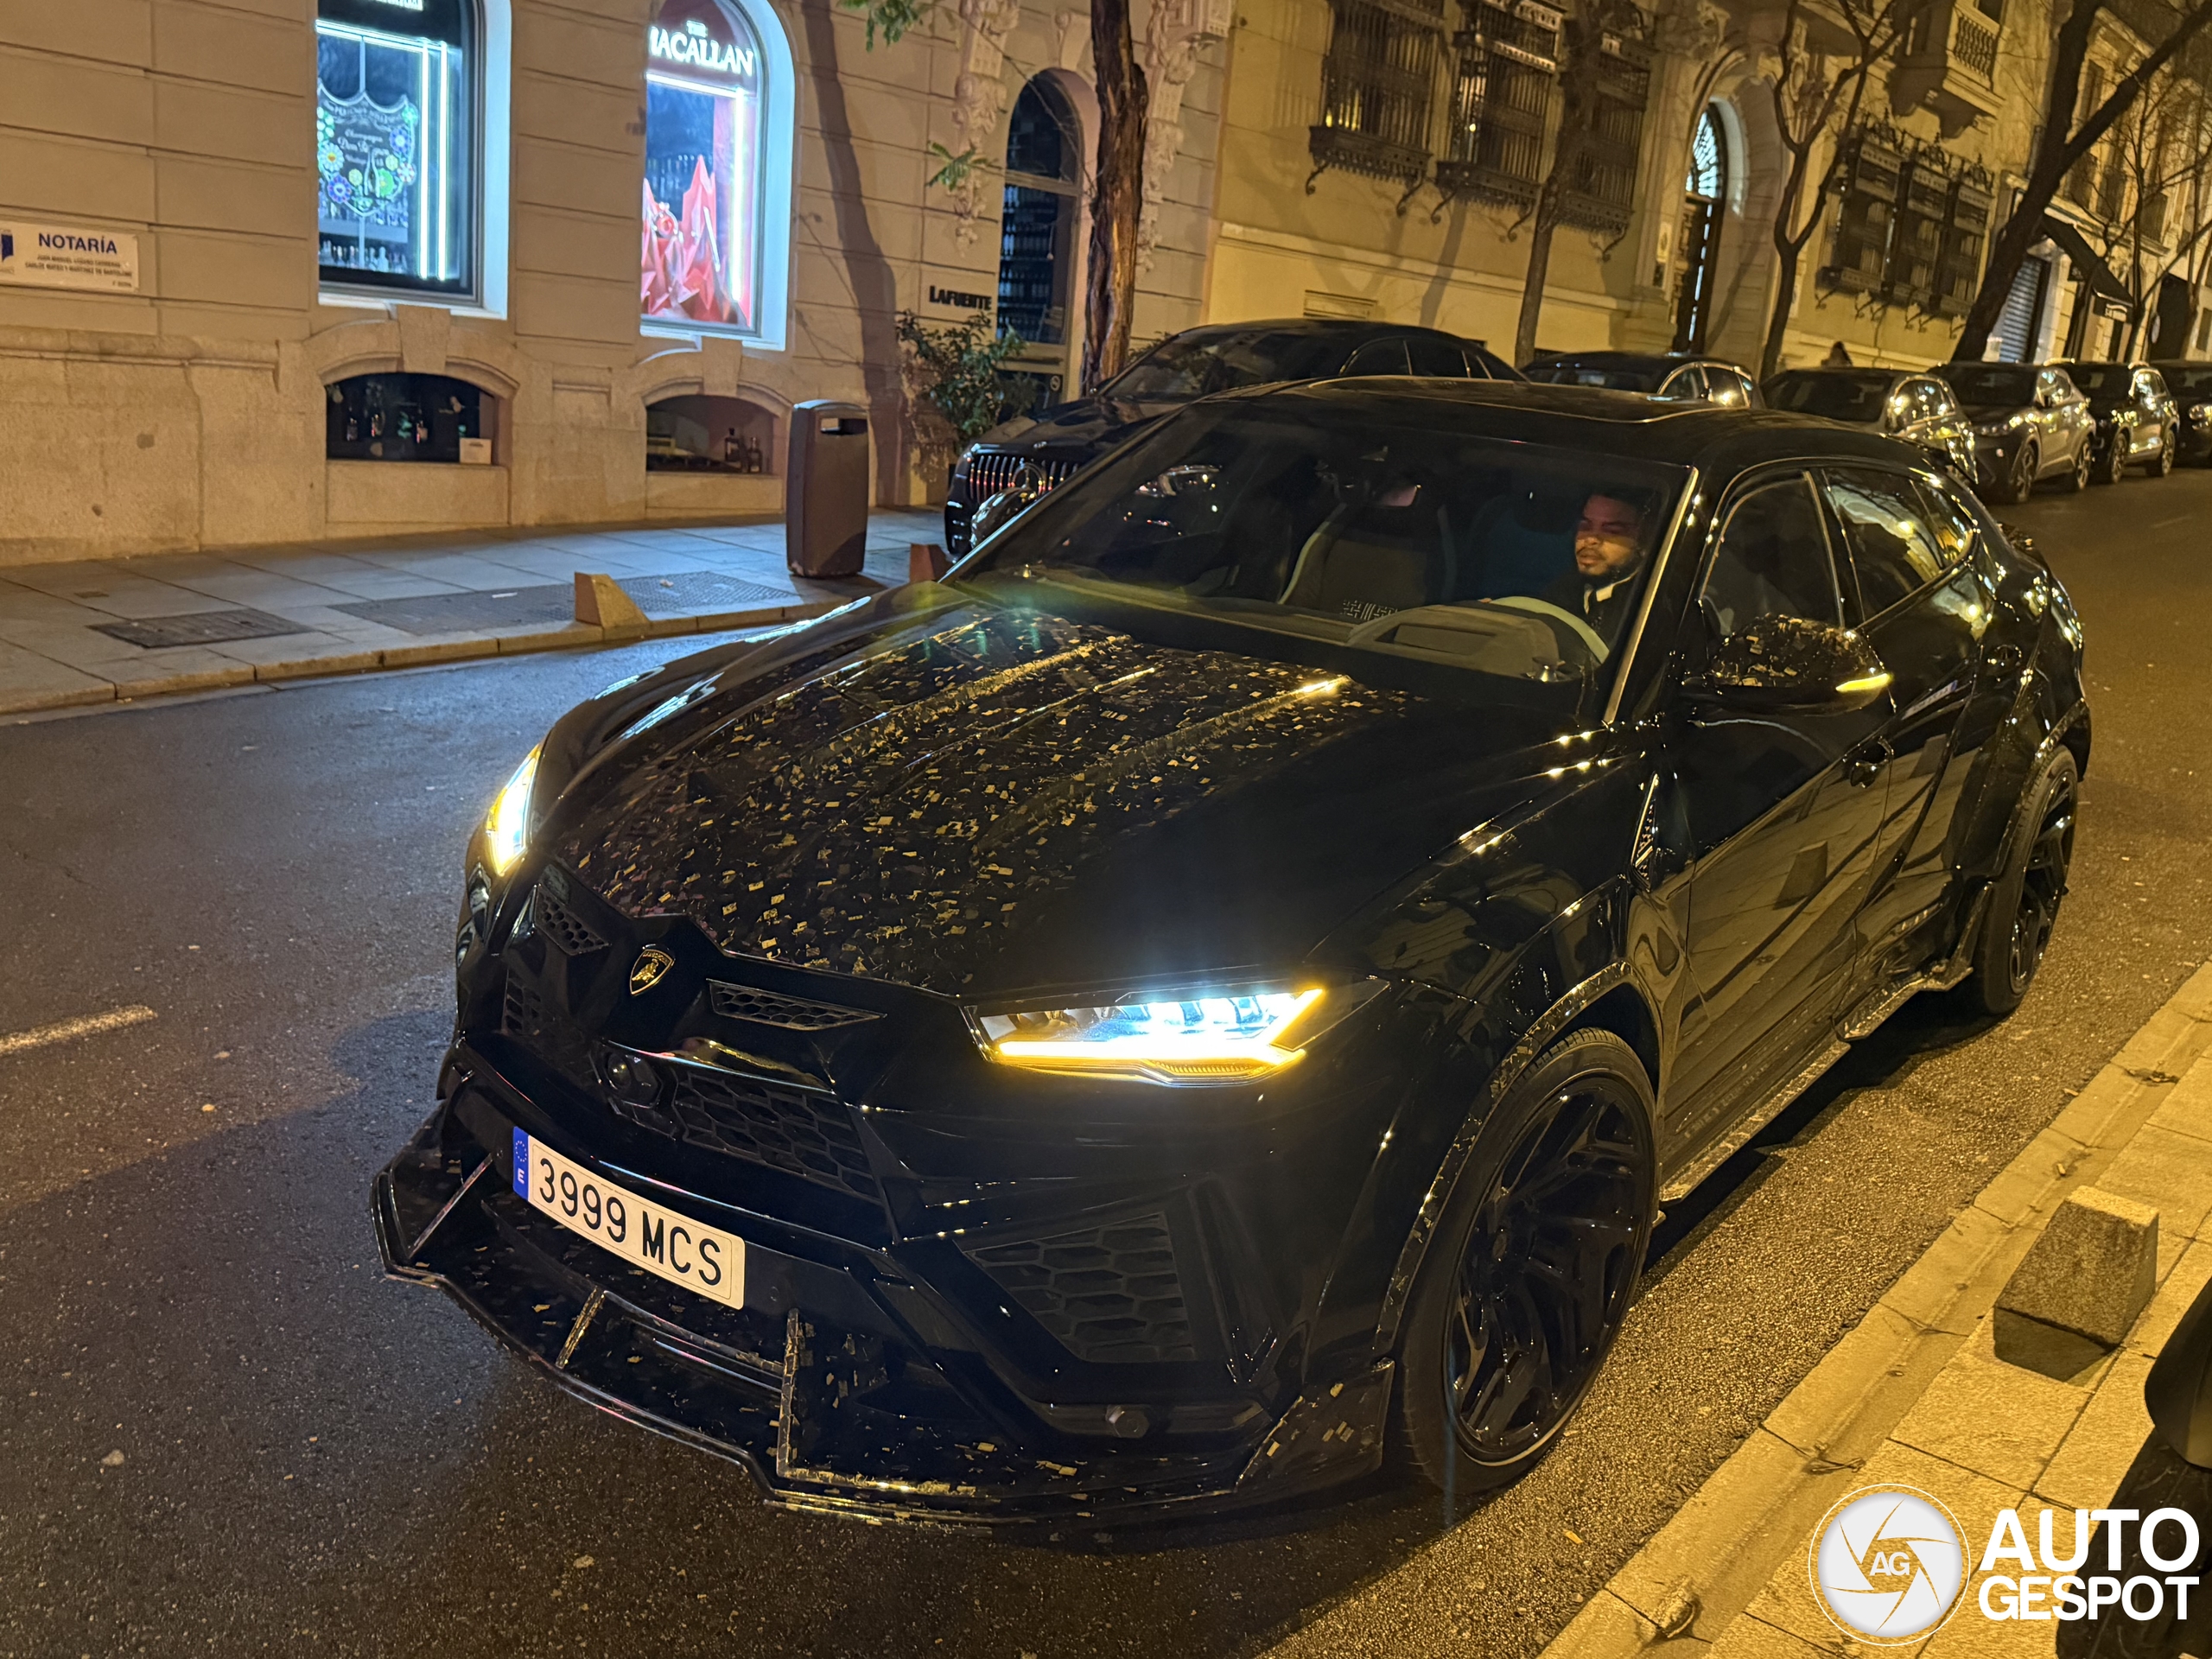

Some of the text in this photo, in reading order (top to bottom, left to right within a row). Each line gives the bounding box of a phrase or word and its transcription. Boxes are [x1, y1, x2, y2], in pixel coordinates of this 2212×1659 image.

[38, 233, 117, 254] NOTARÍA
[929, 285, 992, 310] LAFUENTE
[517, 1168, 525, 1185] E
[539, 1157, 721, 1286] 3999 MCS
